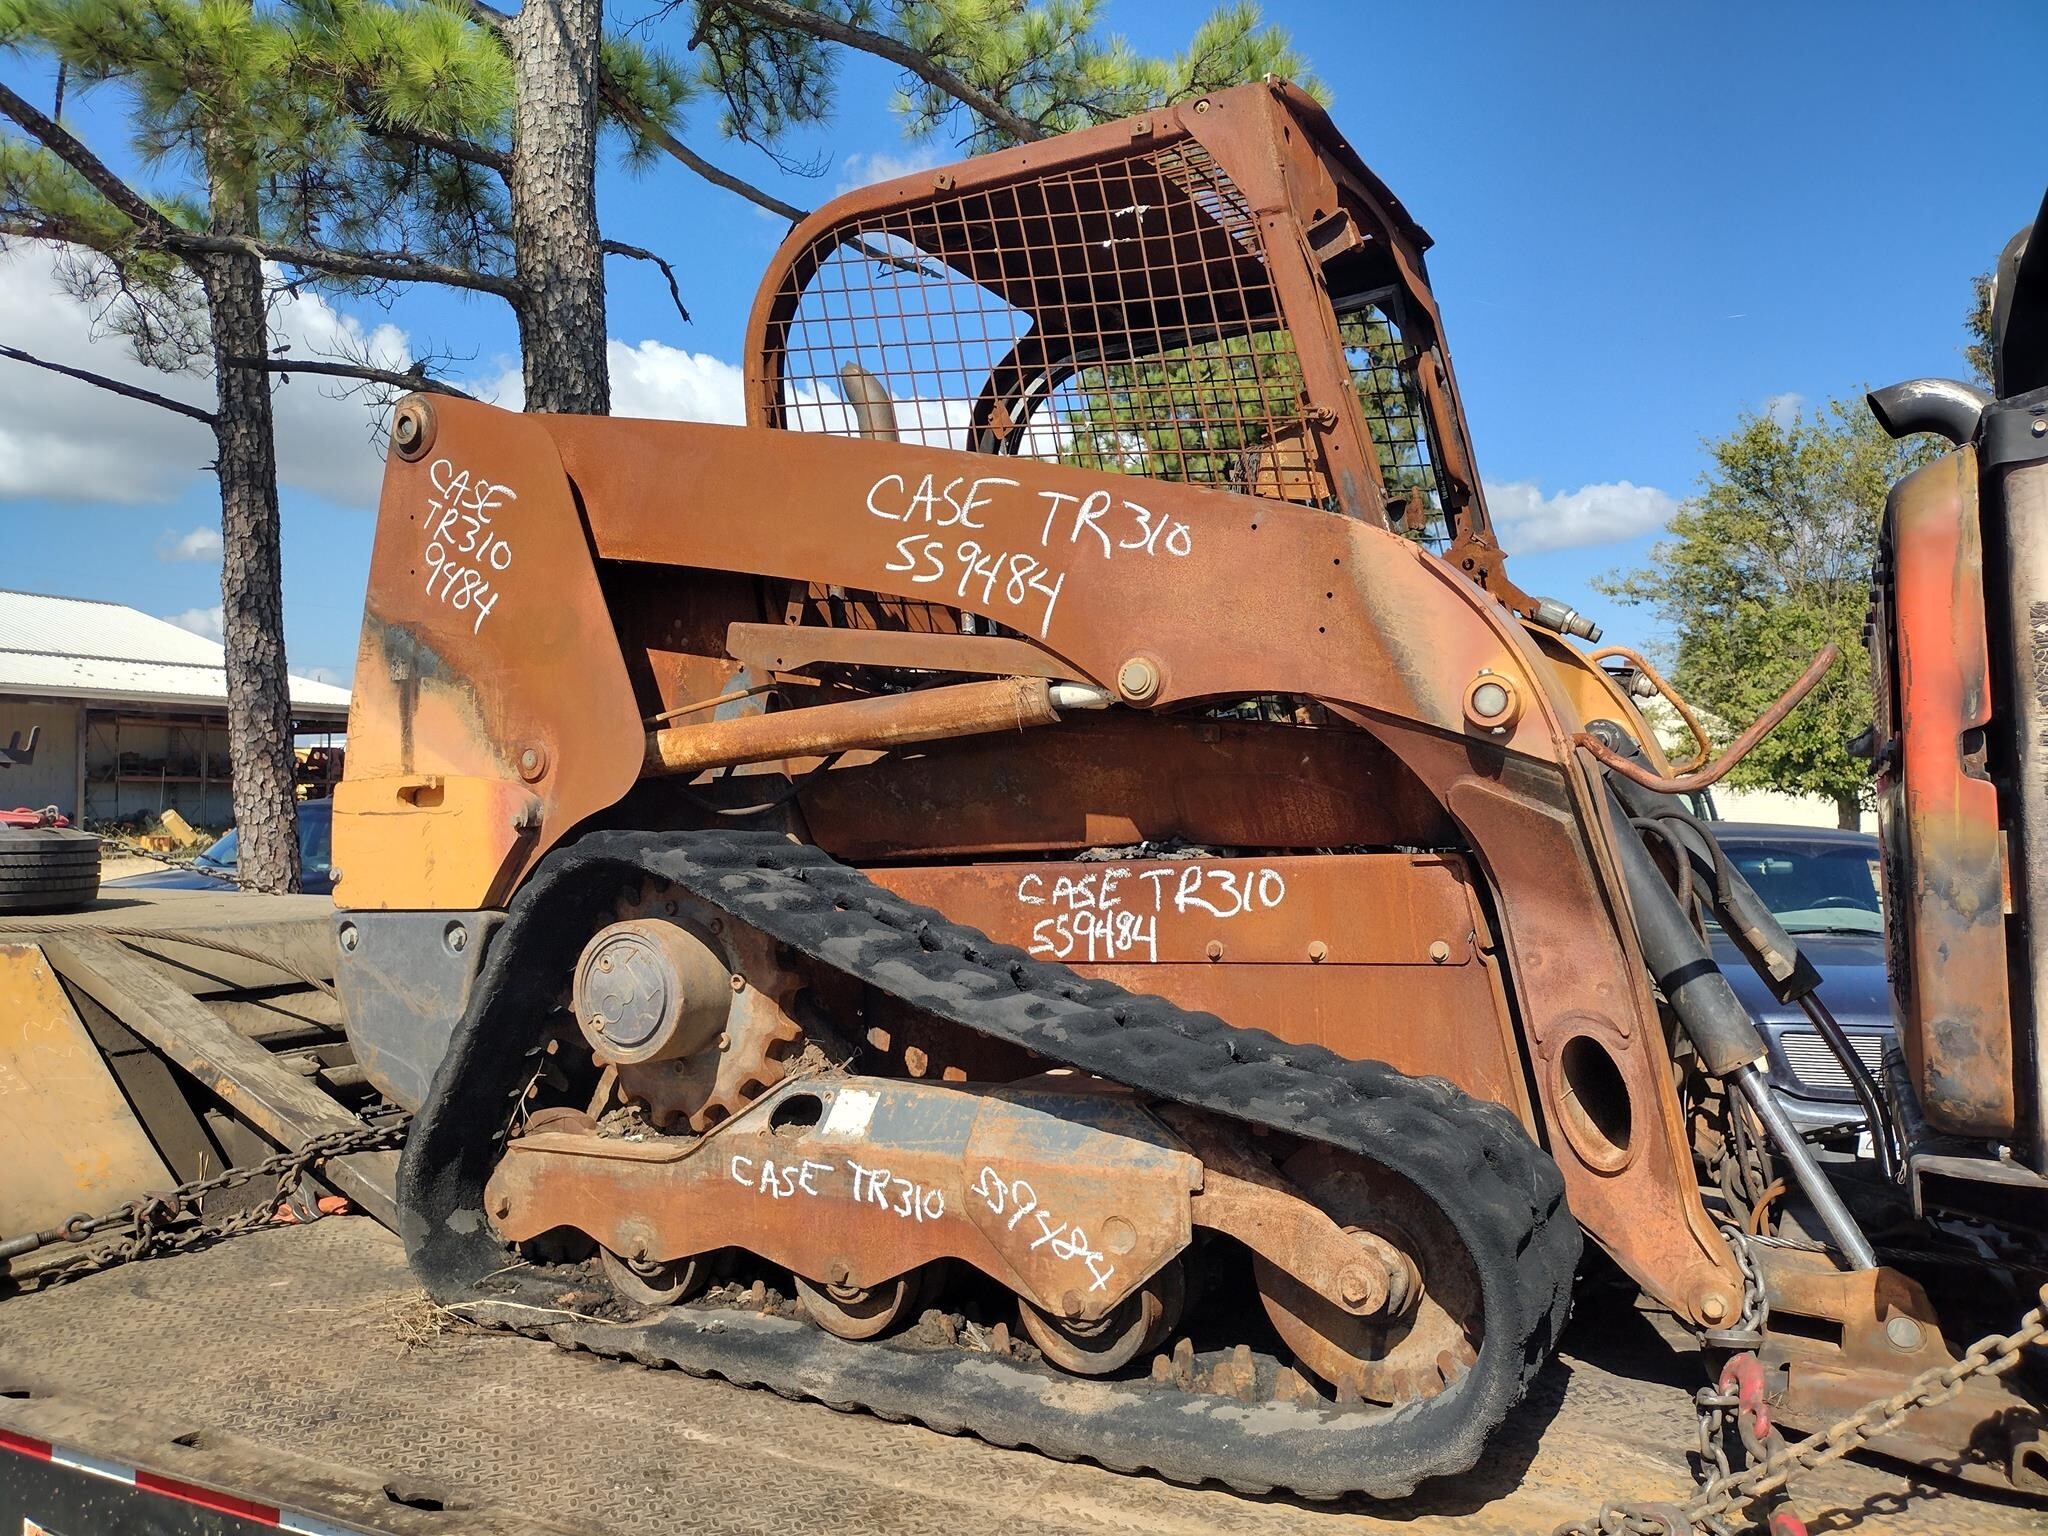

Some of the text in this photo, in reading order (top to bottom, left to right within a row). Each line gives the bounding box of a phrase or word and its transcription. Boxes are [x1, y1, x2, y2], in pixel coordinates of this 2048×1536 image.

[430, 459, 518, 523] CASE
[866, 473, 1193, 559] CASE TR310
[423, 498, 512, 570] TR310
[425, 541, 499, 635] 9484
[1017, 865, 1286, 918] CASE TR310
[730, 1155, 945, 1223] CASE TR310
